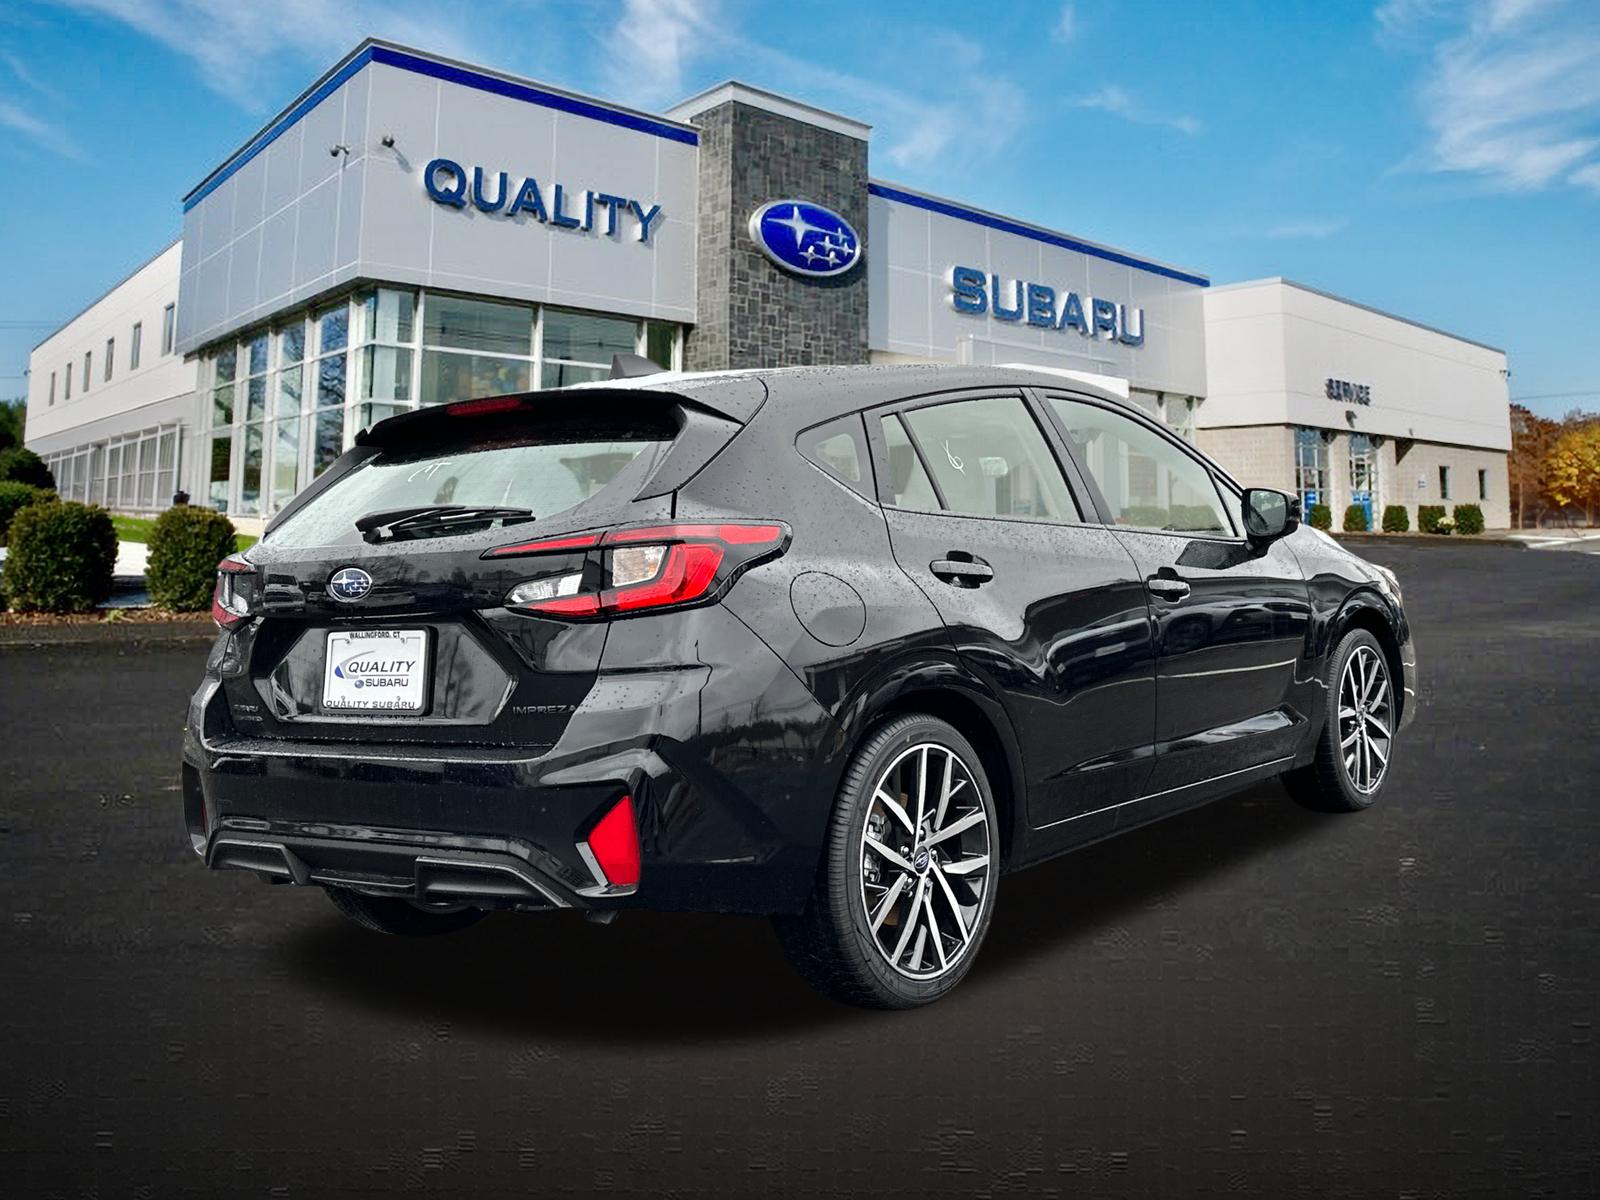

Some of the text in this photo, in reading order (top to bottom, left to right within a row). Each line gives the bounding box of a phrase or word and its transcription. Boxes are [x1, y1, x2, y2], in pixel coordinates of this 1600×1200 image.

[424, 158, 661, 242] QUALITY
[946, 265, 1145, 346] SUBARU
[1324, 378, 1371, 406] SERVICE
[348, 661, 416, 673] QUALITY
[365, 678, 409, 687] SUBARU
[326, 700, 415, 709] QUALITY SUBARU
[512, 704, 577, 714] IMPREZA
